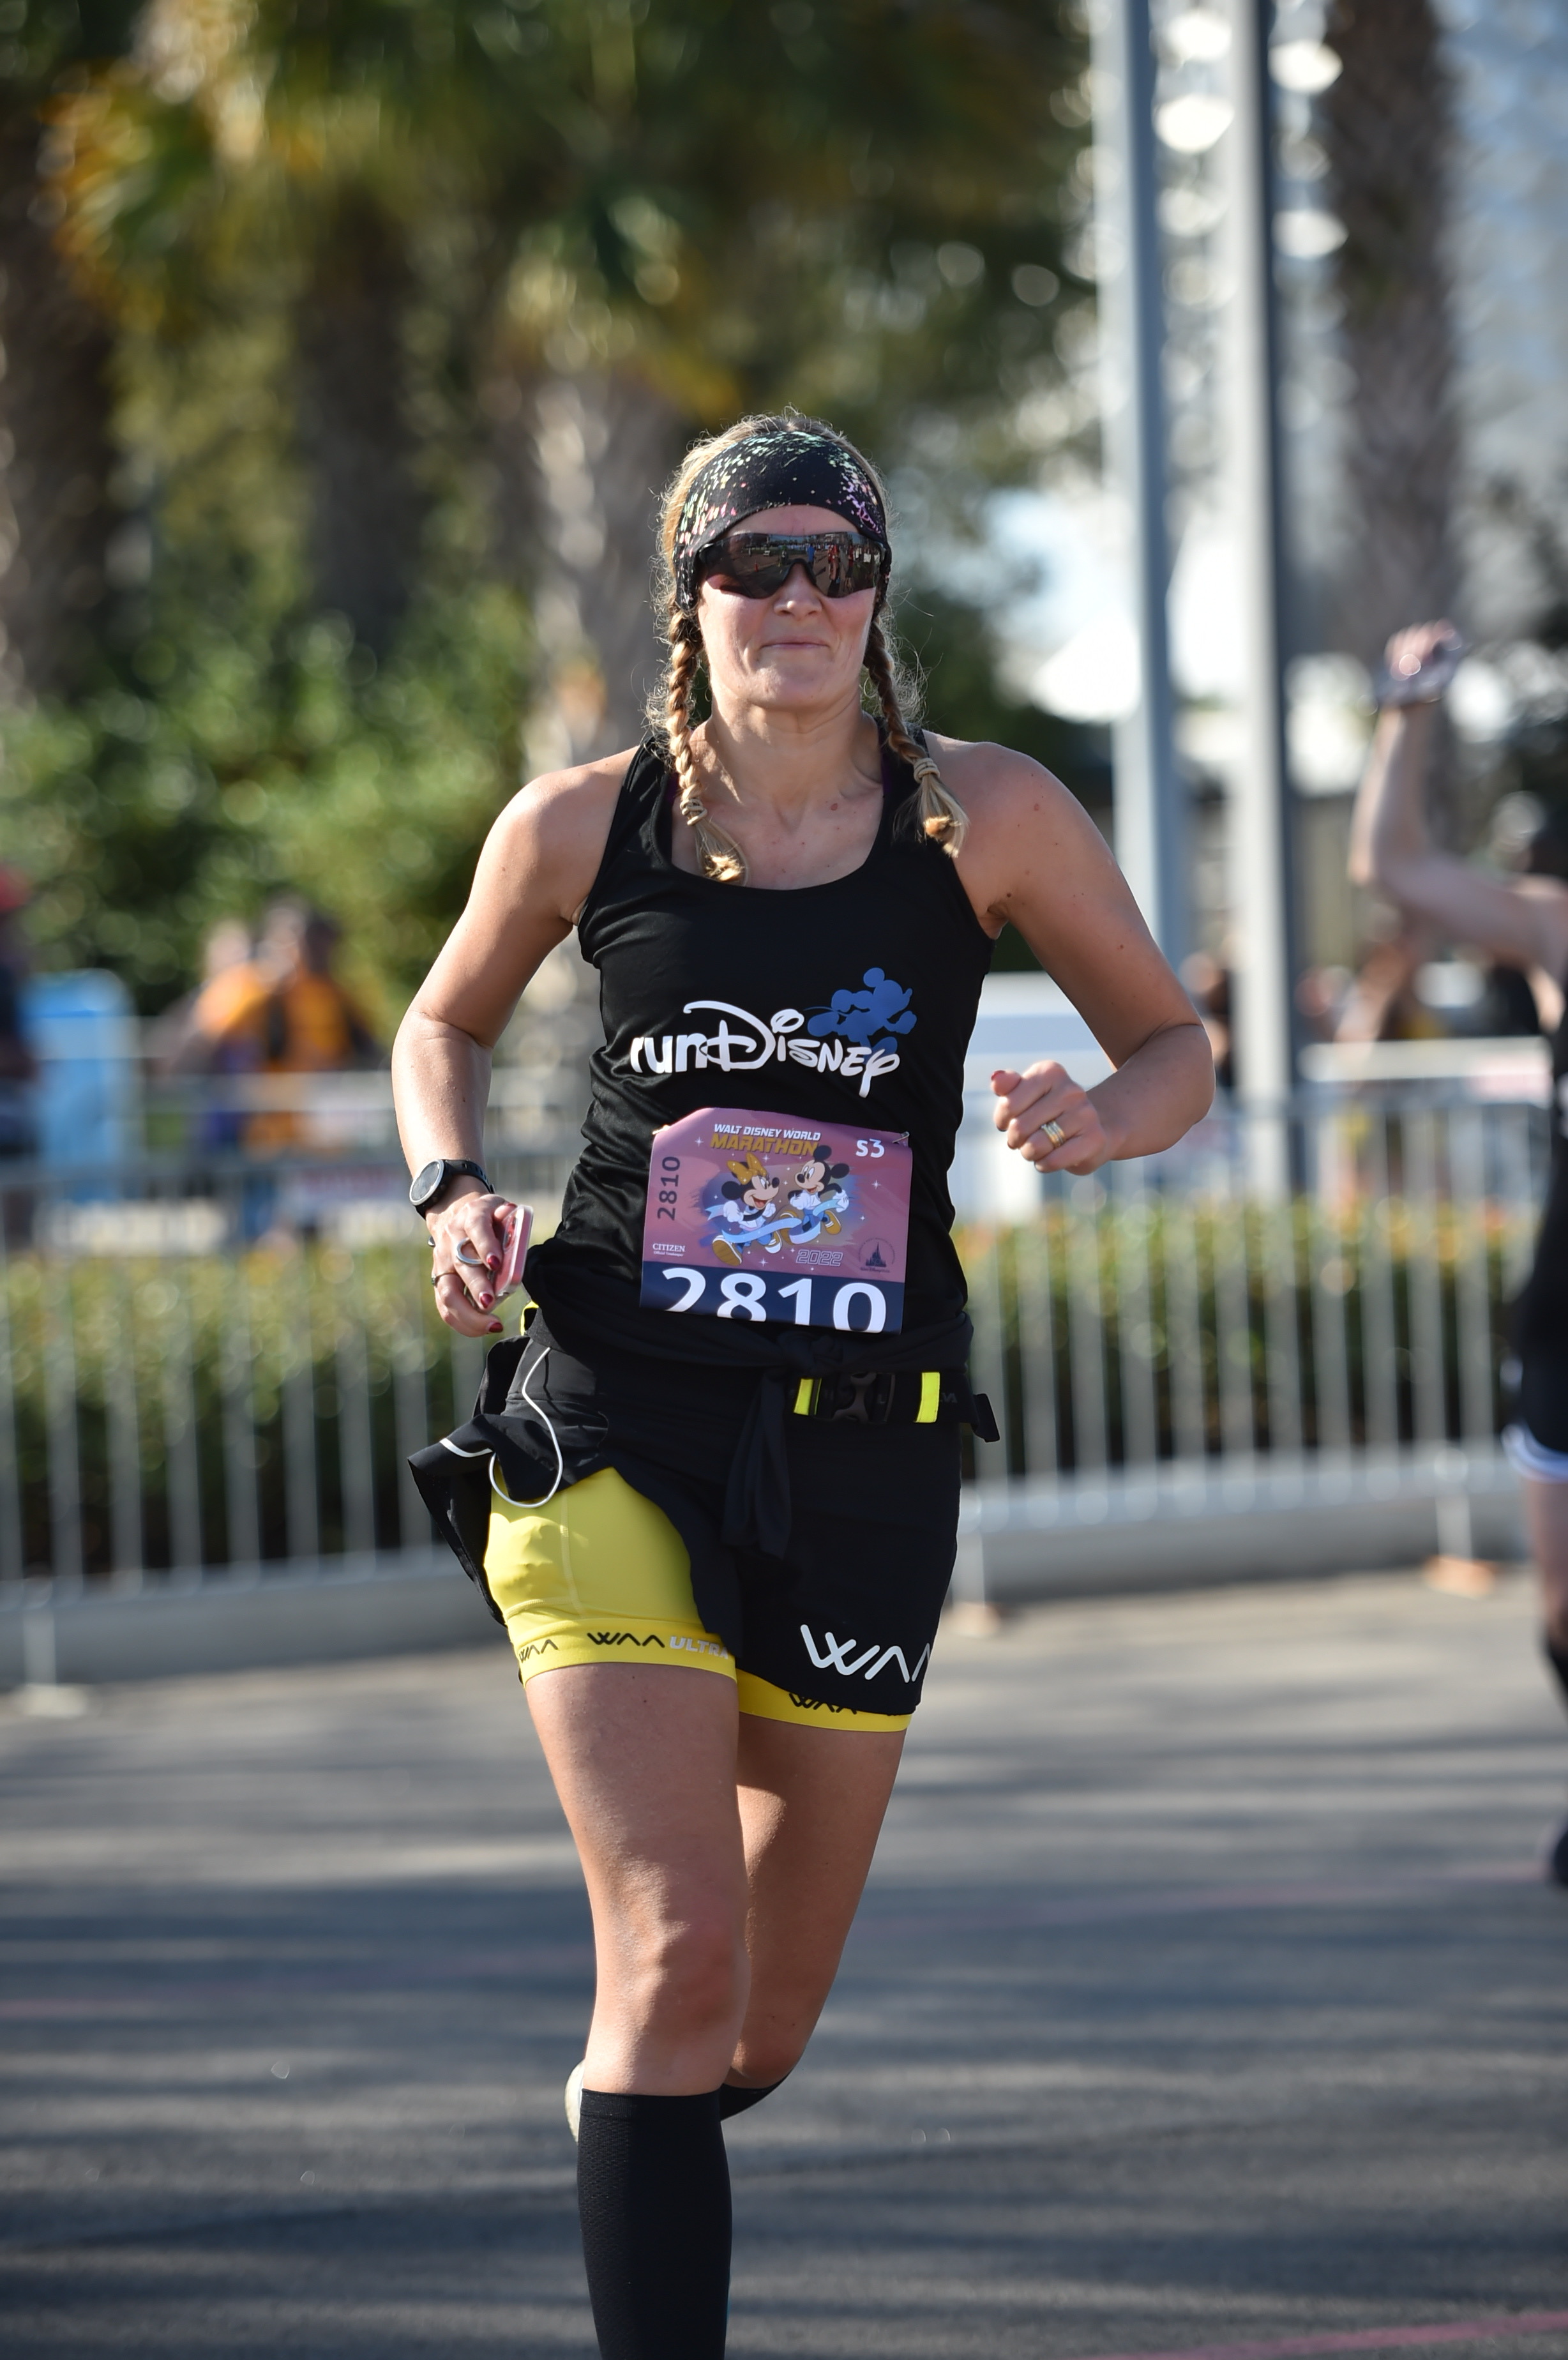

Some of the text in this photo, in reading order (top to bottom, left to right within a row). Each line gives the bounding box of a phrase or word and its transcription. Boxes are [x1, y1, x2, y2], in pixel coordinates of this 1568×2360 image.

[714, 1123, 821, 1141] WALT DISNEY WORLD
[710, 1133, 819, 1156] MARATHON
[856, 1138, 885, 1158] S3
[657, 1156, 681, 1221] 2810
[652, 1243, 686, 1252] CITIZEN
[795, 1249, 843, 1266] 2022
[662, 1267, 887, 1333] 2810
[670, 1636, 729, 1660] ULTRA
